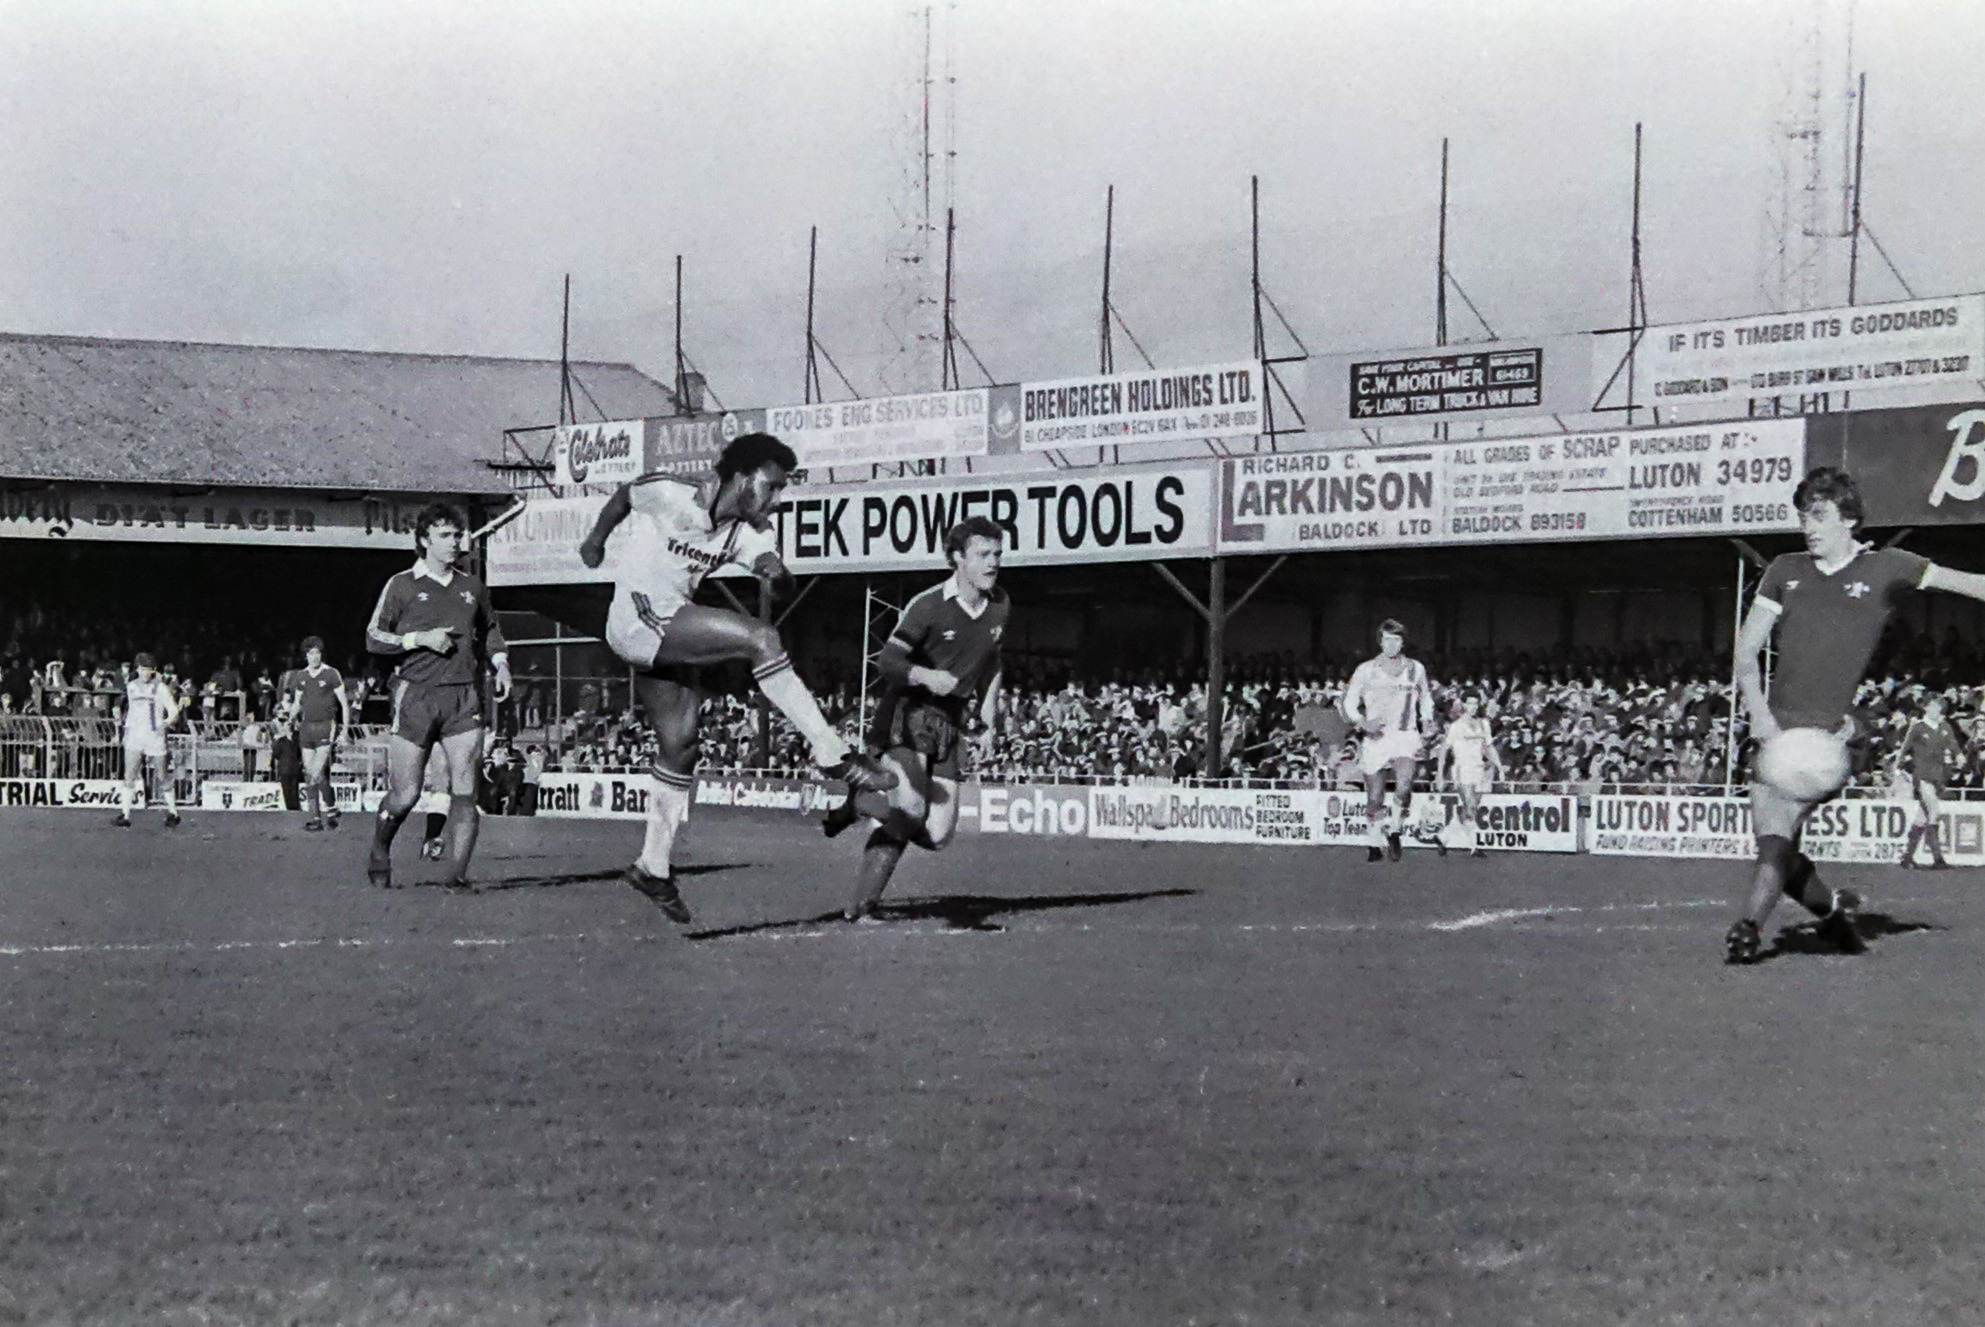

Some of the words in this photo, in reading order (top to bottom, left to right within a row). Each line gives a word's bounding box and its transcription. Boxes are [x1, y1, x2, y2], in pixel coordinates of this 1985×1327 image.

[1669, 334, 1686, 352] IF
[1735, 321, 1805, 347] TIMBER
[1851, 306, 1959, 336] GODDARDS
[876, 395, 949, 423] SERVICES
[1024, 382, 1122, 423] BRENGREEN
[1128, 373, 1213, 413] HOLDINGS
[1218, 369, 1256, 406] LTD.
[656, 421, 722, 456] AZTEC
[1092, 421, 1130, 438] LONDON
[1453, 449, 1477, 466] ALL
[1485, 445, 1531, 463] GRADES
[1563, 436, 1620, 459] SCRAP
[1630, 433, 1711, 455] PURCHASED
[1243, 454, 1330, 475] RICHARD
[1928, 408, 1985, 508] B
[1629, 462, 1701, 490] LUTON
[1716, 456, 1793, 486] 34979
[204, 507, 316, 532] LAGER
[1027, 475, 1186, 550] TOOLS
[1452, 514, 1522, 534] BALDOCK
[1628, 506, 1723, 528] COTTENHAM
[1299, 520, 1379, 541] BALDOCK
[1399, 518, 1432, 535] LTD
[69, 782, 145, 805] Servics
[1256, 794, 1291, 808] FITTED
[1170, 794, 1255, 830] Bedrooms
[1256, 809, 1304, 824] BEDROOM
[1440, 795, 1571, 833] Tcentrol
[1596, 800, 1670, 832] LUTON
[1676, 802, 1752, 834] SPORT
[1805, 804, 1850, 837] ESS
[1860, 805, 1906, 838] LTD
[1256, 825, 1311, 840] FURNITURE
[1476, 832, 1528, 847] LUTON
